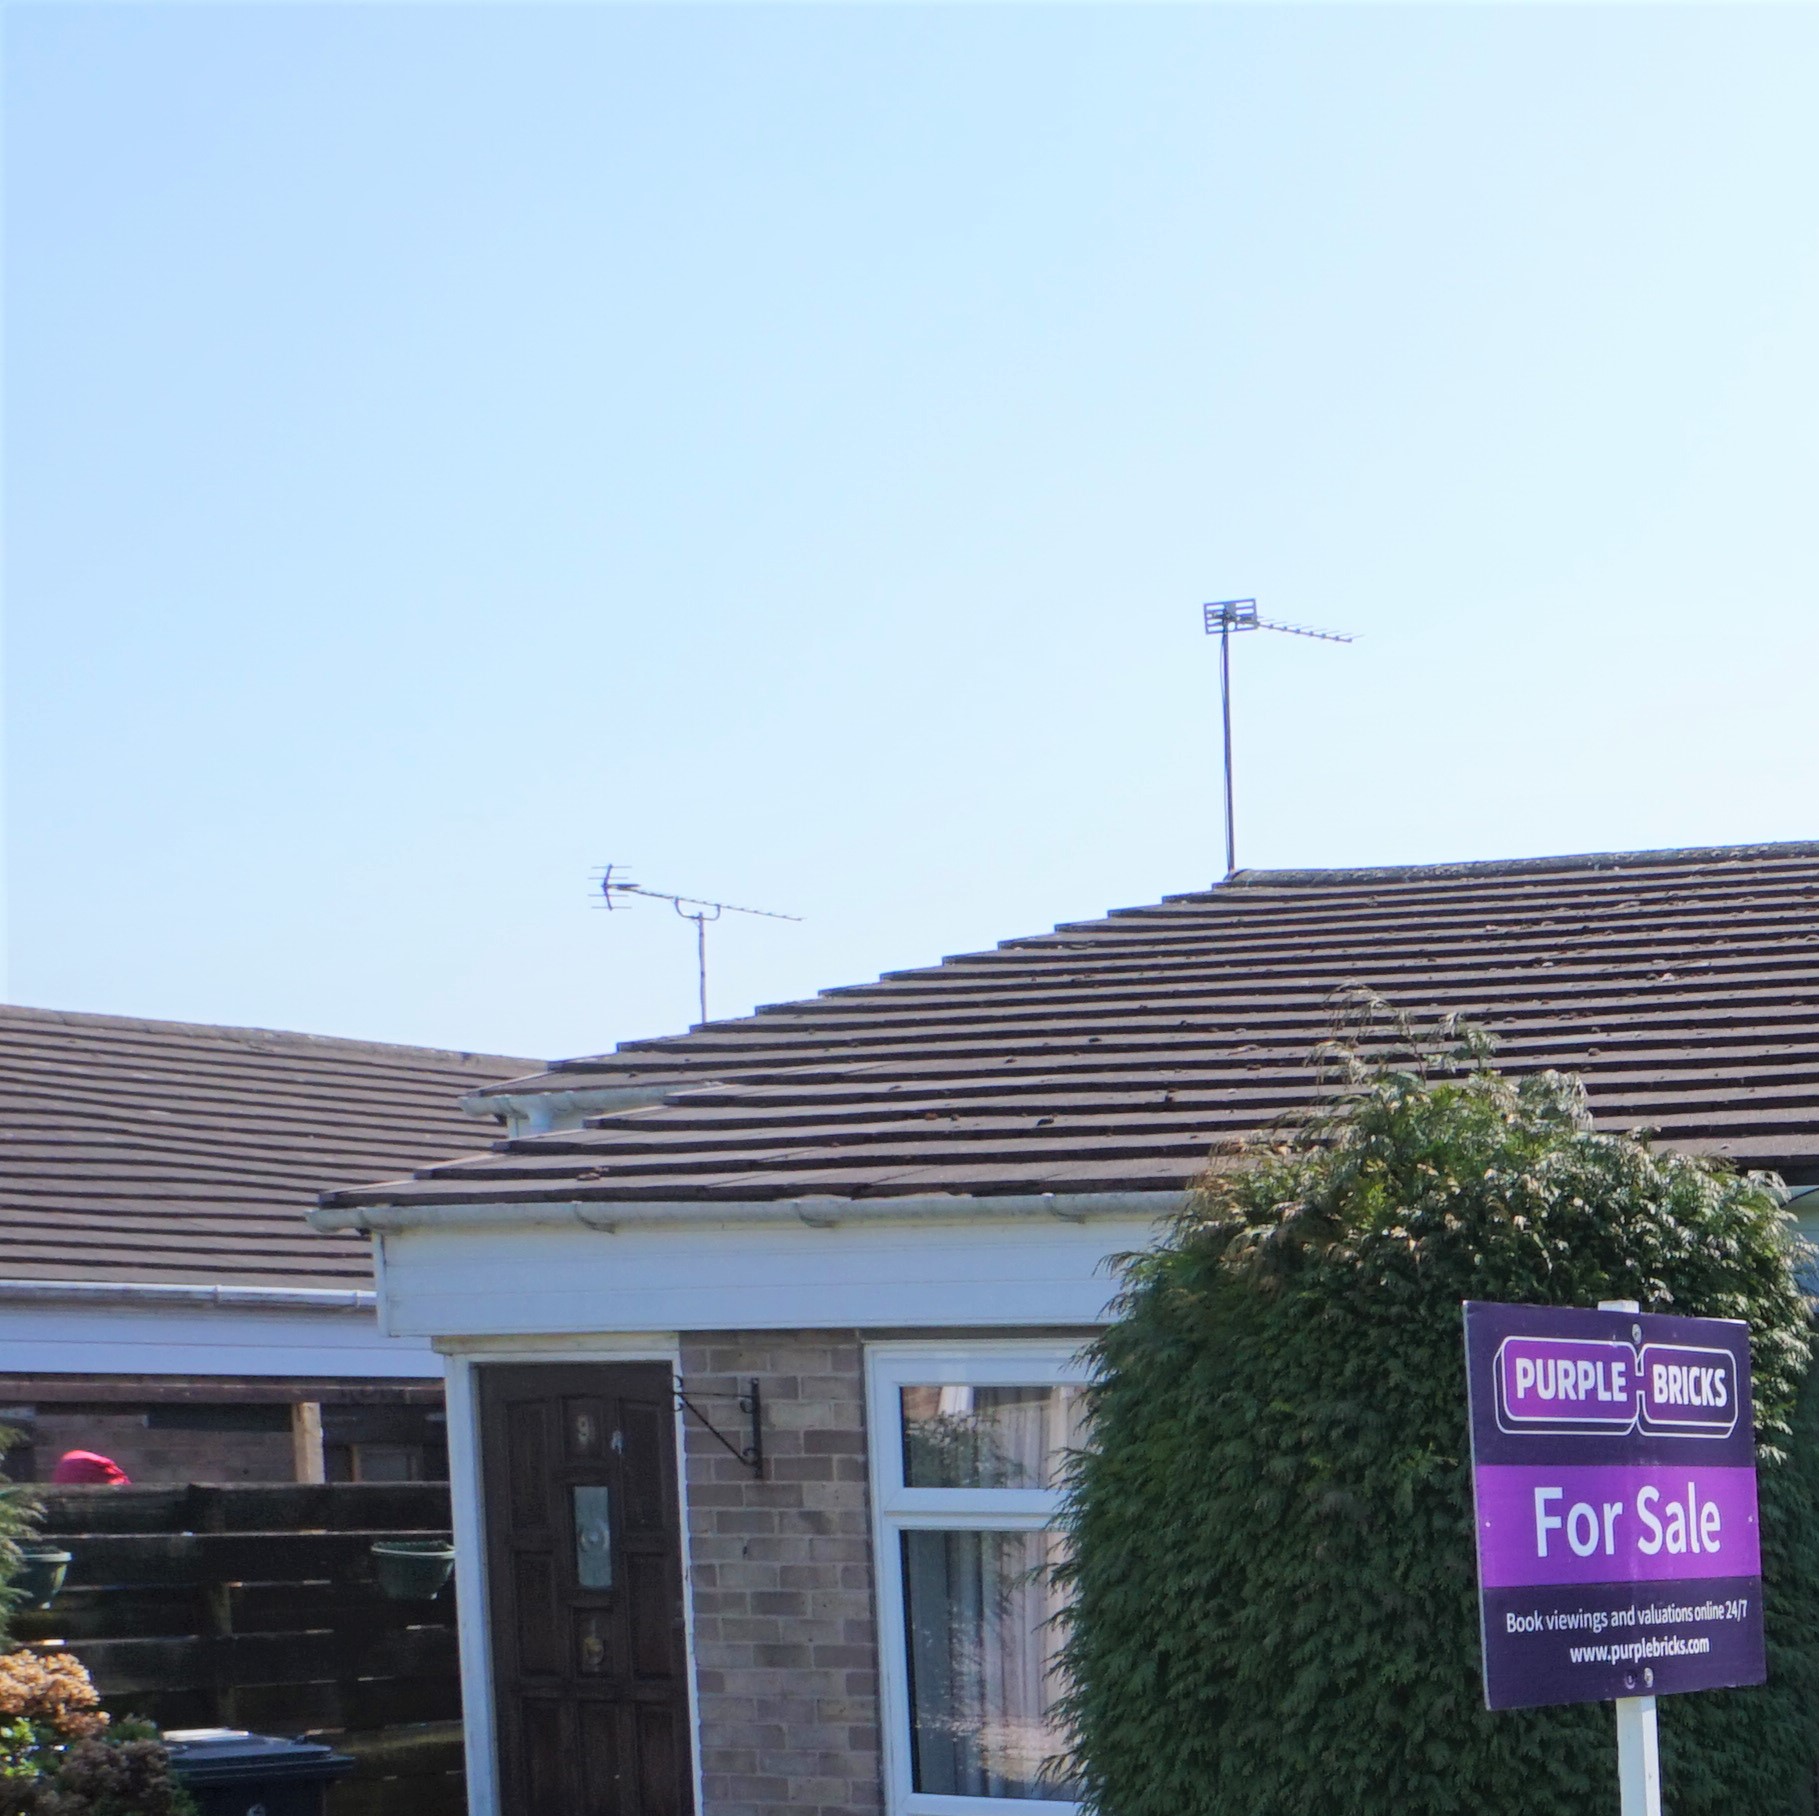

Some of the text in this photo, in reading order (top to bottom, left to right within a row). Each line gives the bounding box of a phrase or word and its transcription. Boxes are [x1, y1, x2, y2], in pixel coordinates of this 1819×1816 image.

[1516, 1358, 1728, 1407] PURPLE BRICKS
[1534, 1481, 1721, 1557] For Sale
[1506, 1599, 1748, 1633] Book viewings and valuations online 24/7
[1570, 1636, 1710, 1665] www.purplebricks.com
